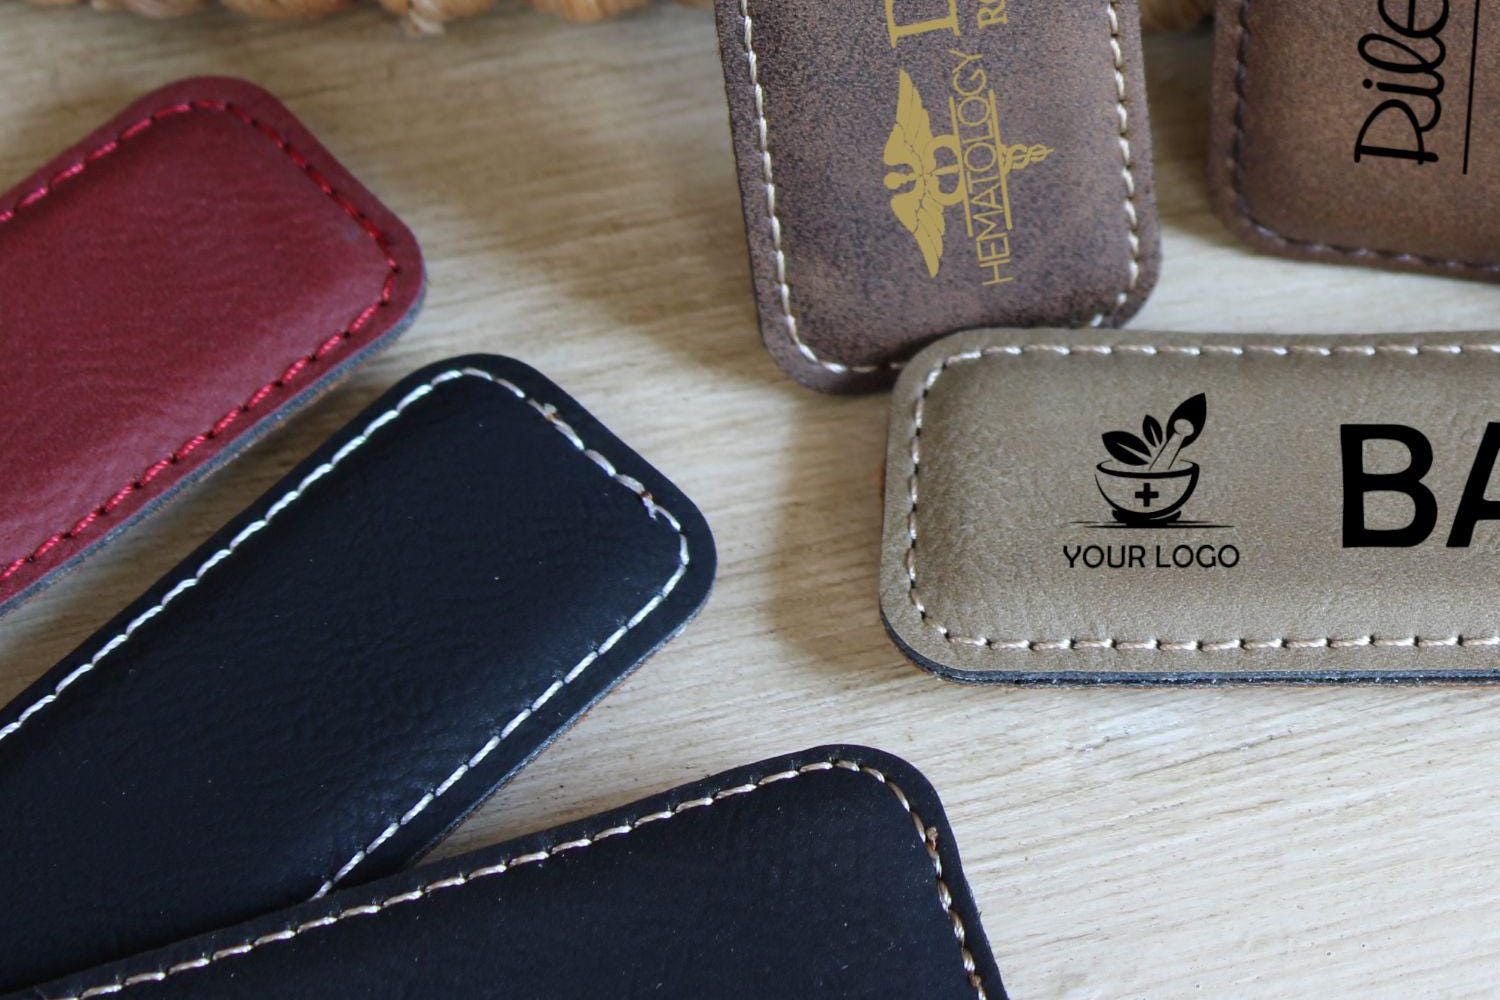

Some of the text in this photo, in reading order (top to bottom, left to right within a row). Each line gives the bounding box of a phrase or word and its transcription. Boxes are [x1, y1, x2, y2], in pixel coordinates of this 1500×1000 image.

[949, 48, 1014, 286] HEMATOLOGY
[1062, 544, 1240, 569] YOUR LOGO
